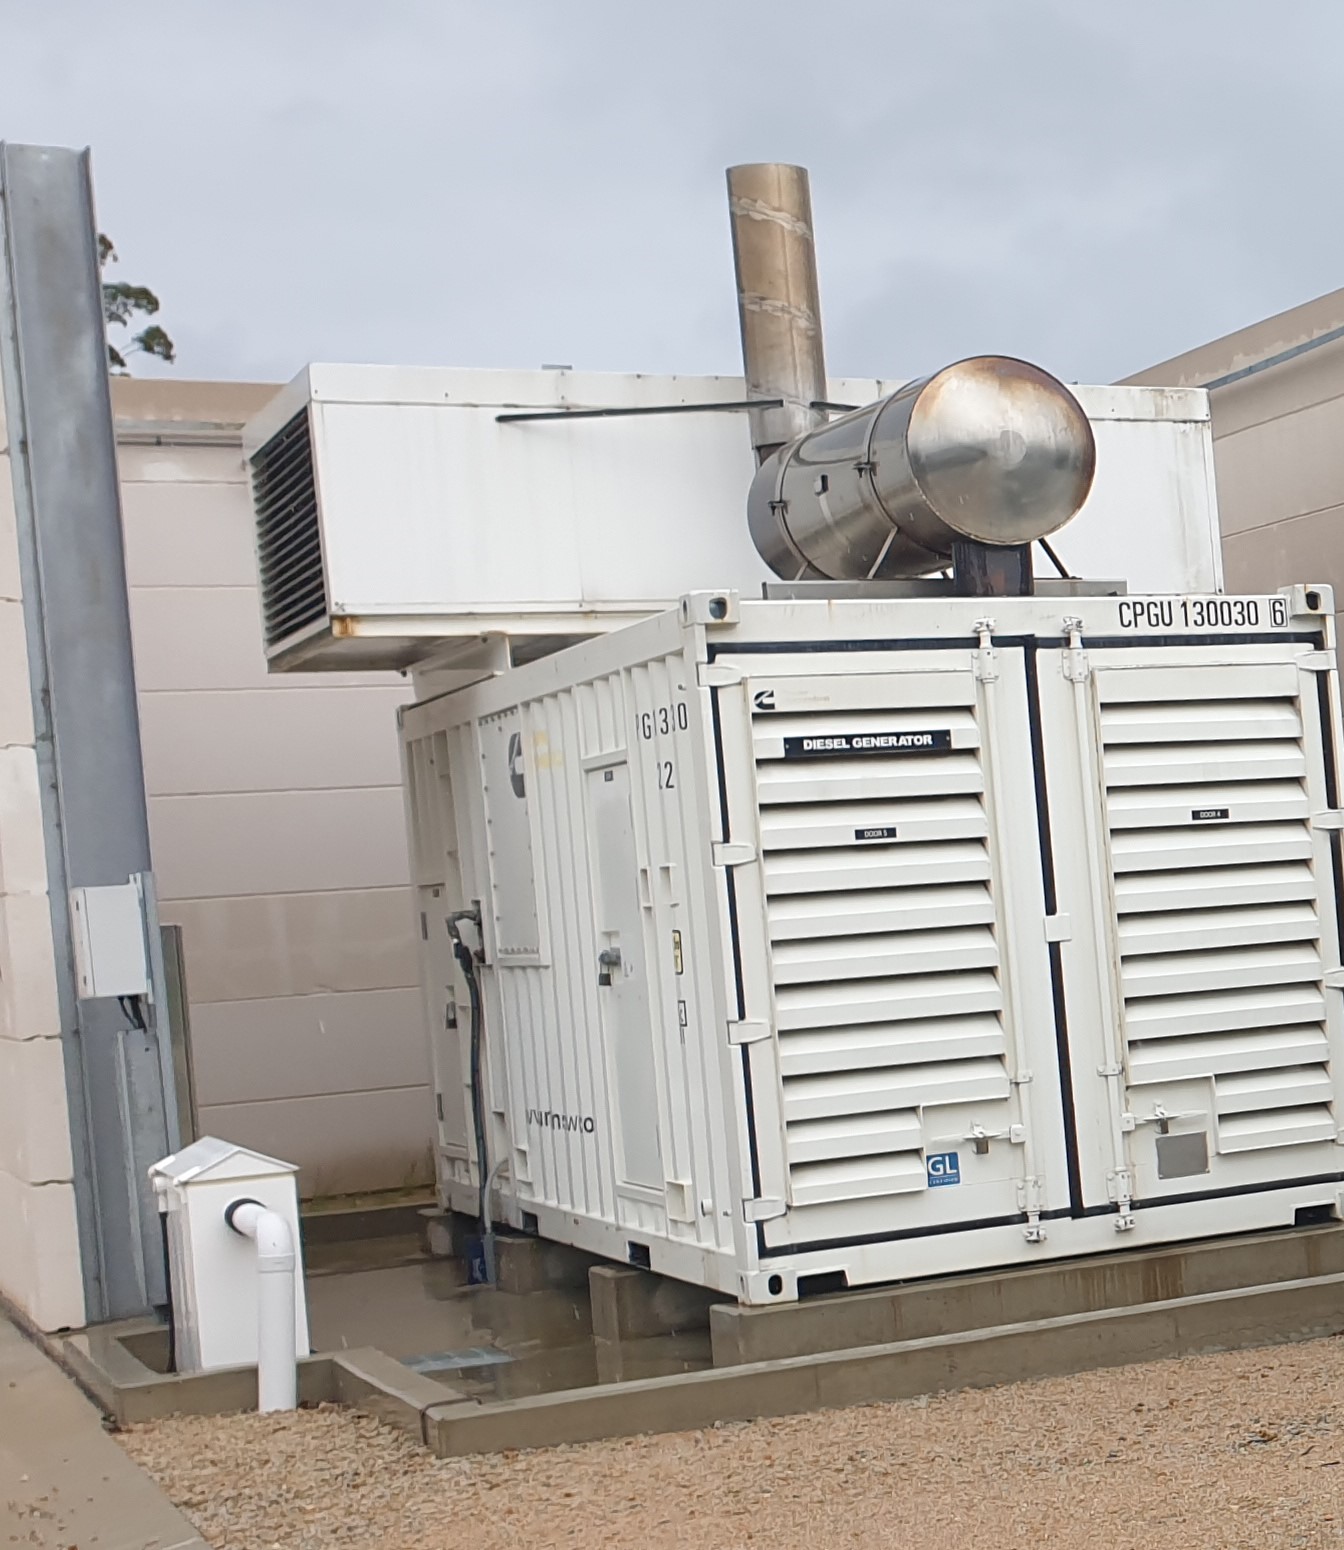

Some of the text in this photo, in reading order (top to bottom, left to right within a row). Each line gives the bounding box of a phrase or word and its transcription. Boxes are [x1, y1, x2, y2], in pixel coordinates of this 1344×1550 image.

[1119, 600, 1285, 628] CPGU 130030 6
[803, 734, 933, 750] DIESEL GENERATOR
[928, 1155, 957, 1176] GL
